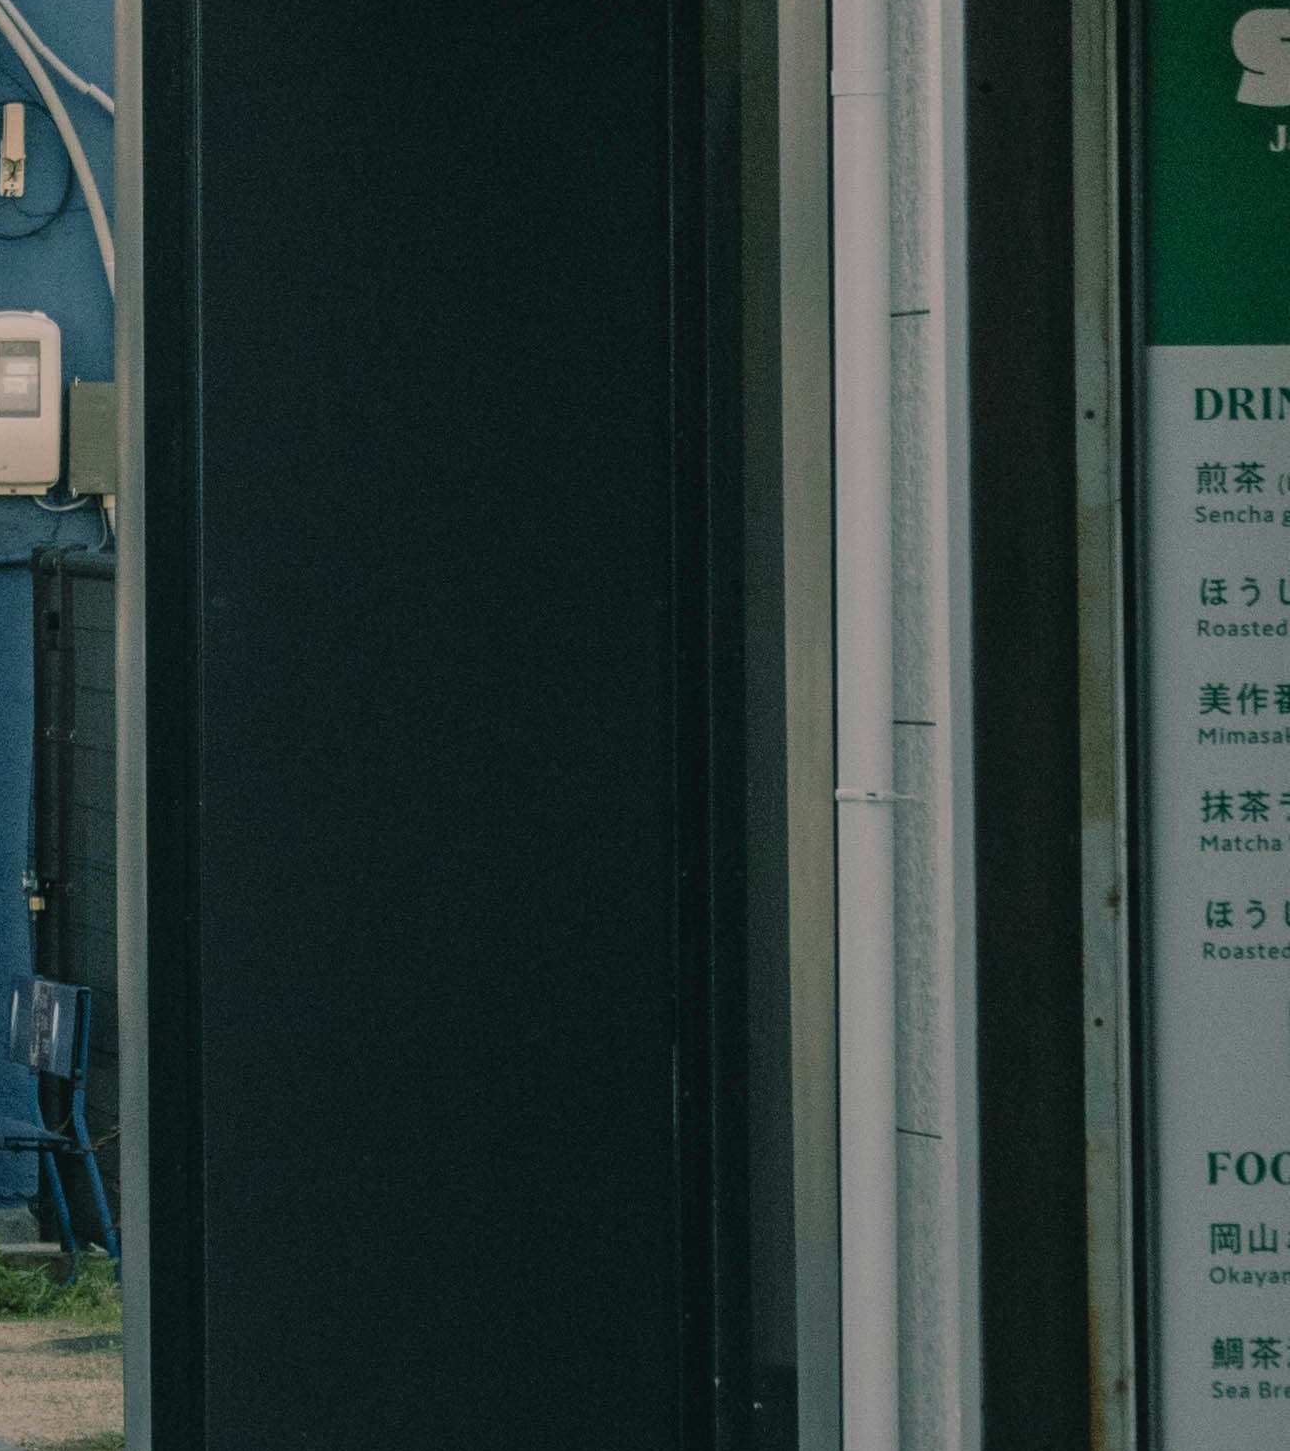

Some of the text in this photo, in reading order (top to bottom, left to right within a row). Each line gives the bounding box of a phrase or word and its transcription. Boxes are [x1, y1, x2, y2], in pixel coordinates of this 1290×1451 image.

[1195, 462, 1266, 494] 煎茶
[1195, 505, 1274, 524] Sencha
[1197, 619, 1287, 637] Roasted
[1201, 834, 1282, 852] Matcha
[1206, 899, 1290, 929] ほう
[1210, 1223, 1290, 1254] 岡山
[1211, 1381, 1250, 1399] Sea
